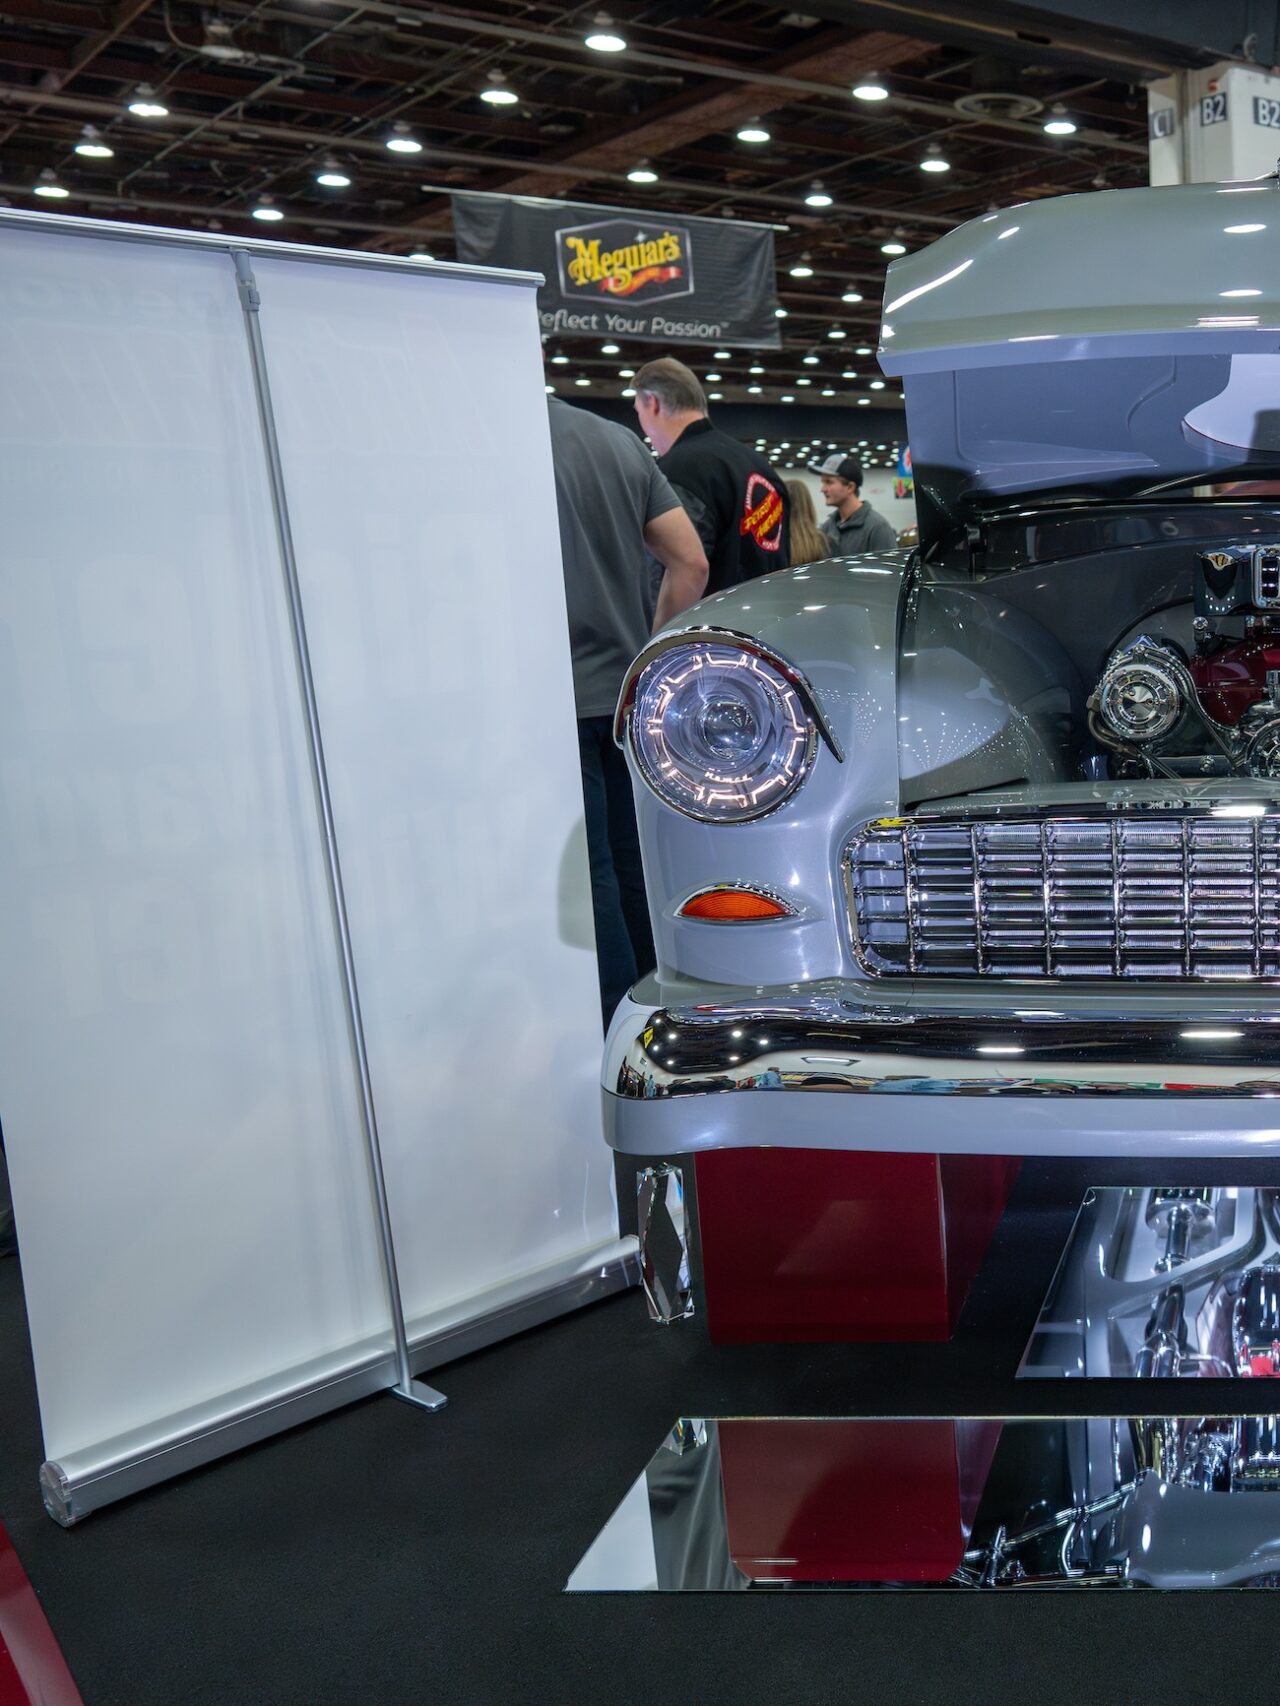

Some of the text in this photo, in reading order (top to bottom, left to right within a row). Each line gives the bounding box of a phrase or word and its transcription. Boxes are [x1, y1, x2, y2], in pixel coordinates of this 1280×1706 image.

[1203, 96, 1225, 125] B2
[565, 231, 683, 293] Meguiar's
[538, 309, 599, 332] eflect
[605, 314, 648, 334] Your
